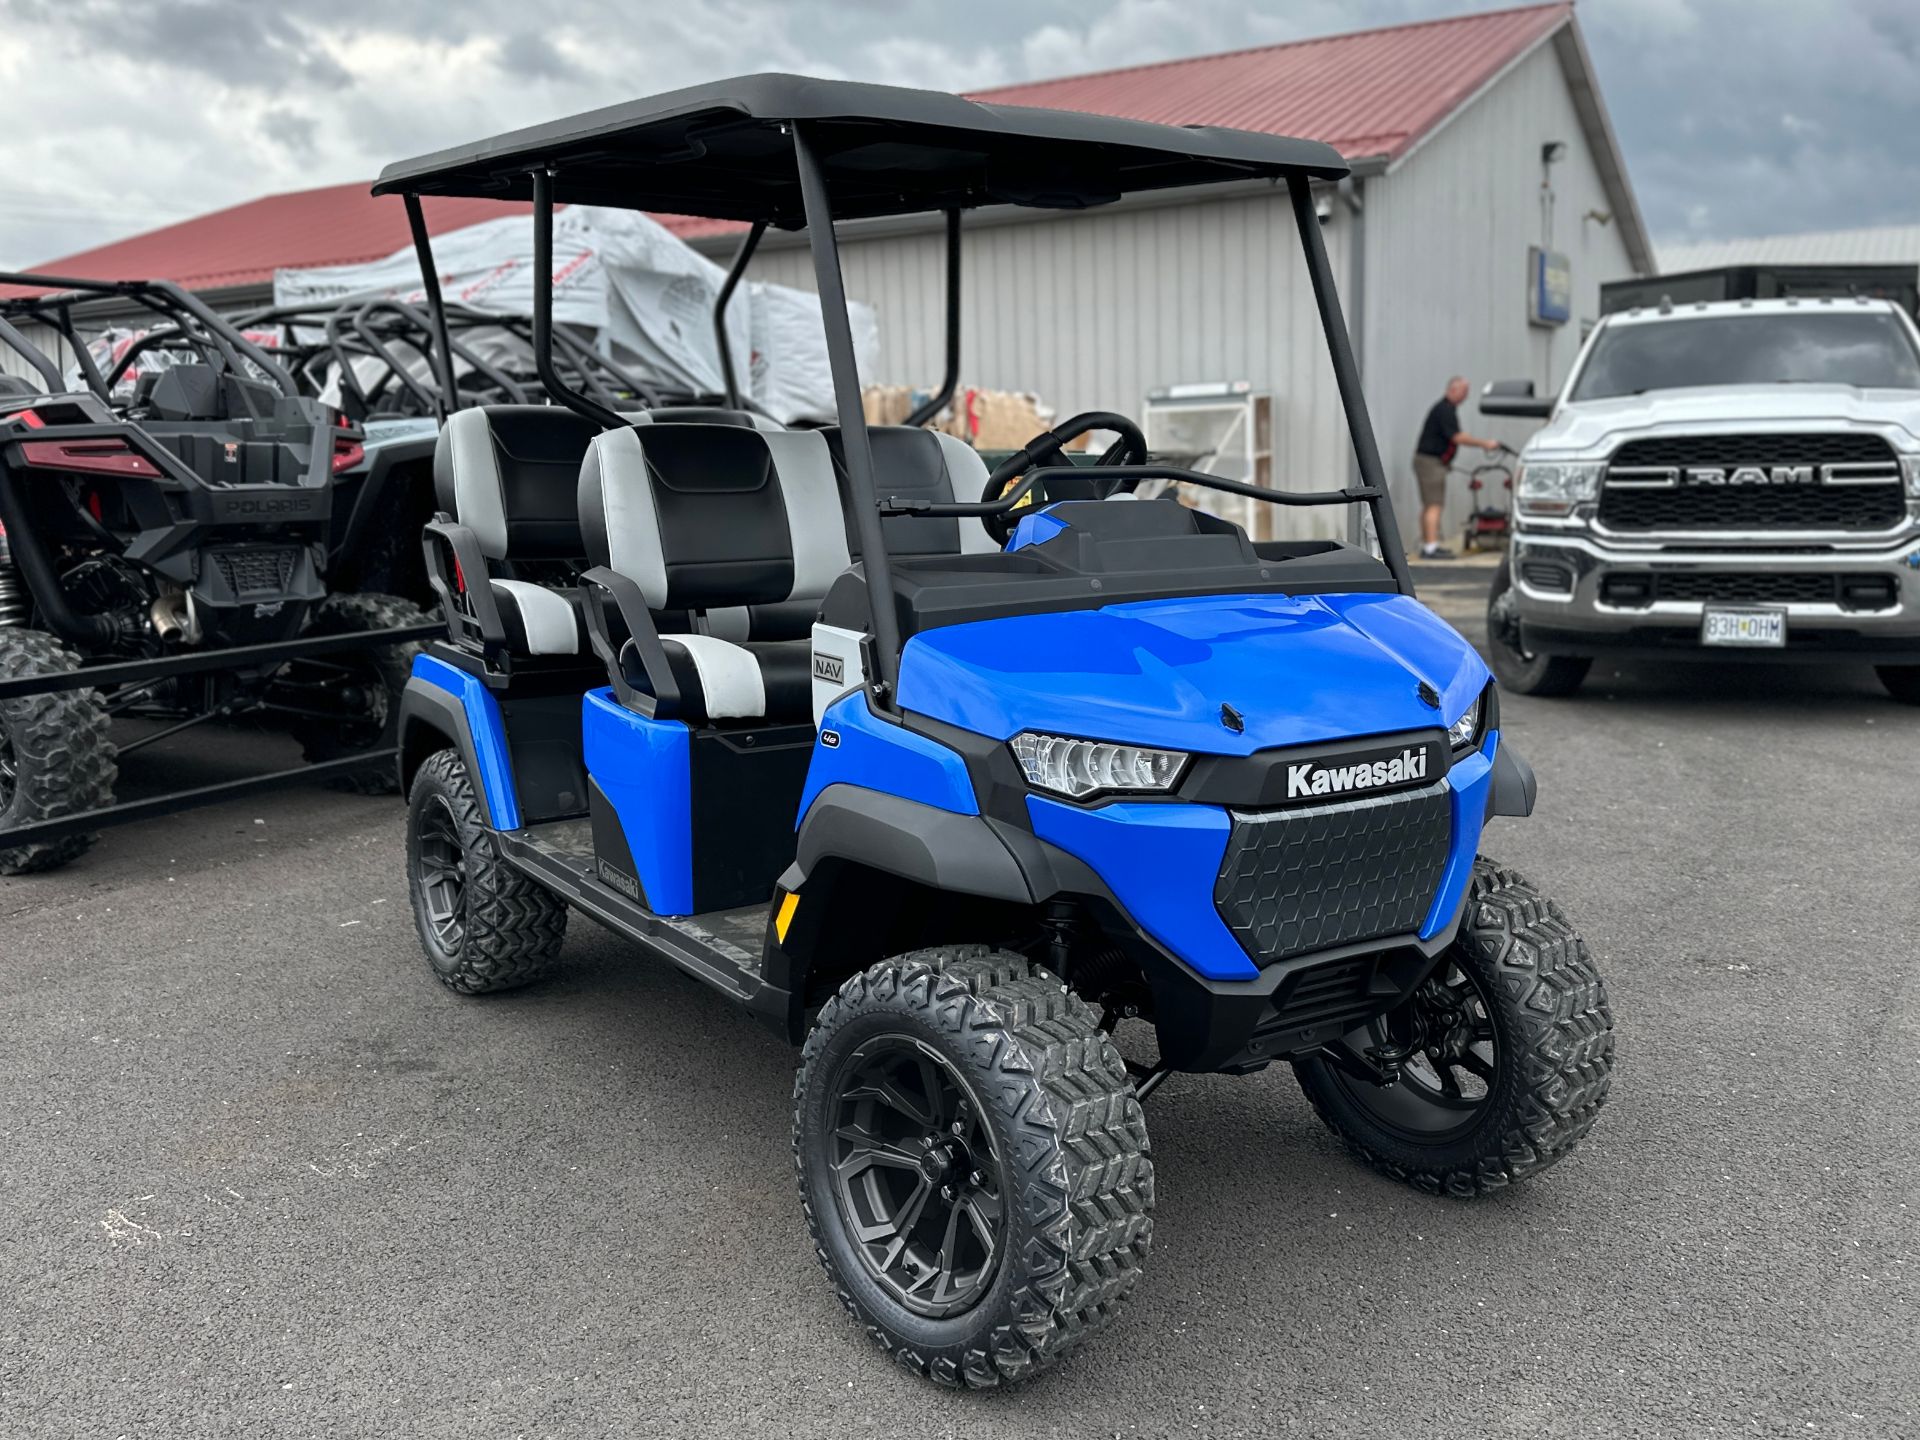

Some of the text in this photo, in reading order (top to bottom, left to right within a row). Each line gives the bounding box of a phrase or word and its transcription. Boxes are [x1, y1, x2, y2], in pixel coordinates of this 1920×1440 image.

[1687, 467, 1813, 485] RAM
[226, 500, 312, 514] POLARIS
[1707, 616, 1739, 636] 83H
[815, 659, 842, 679] NAV
[1287, 747, 1427, 798] Kawasaki
[598, 859, 639, 900] Kawasaki
